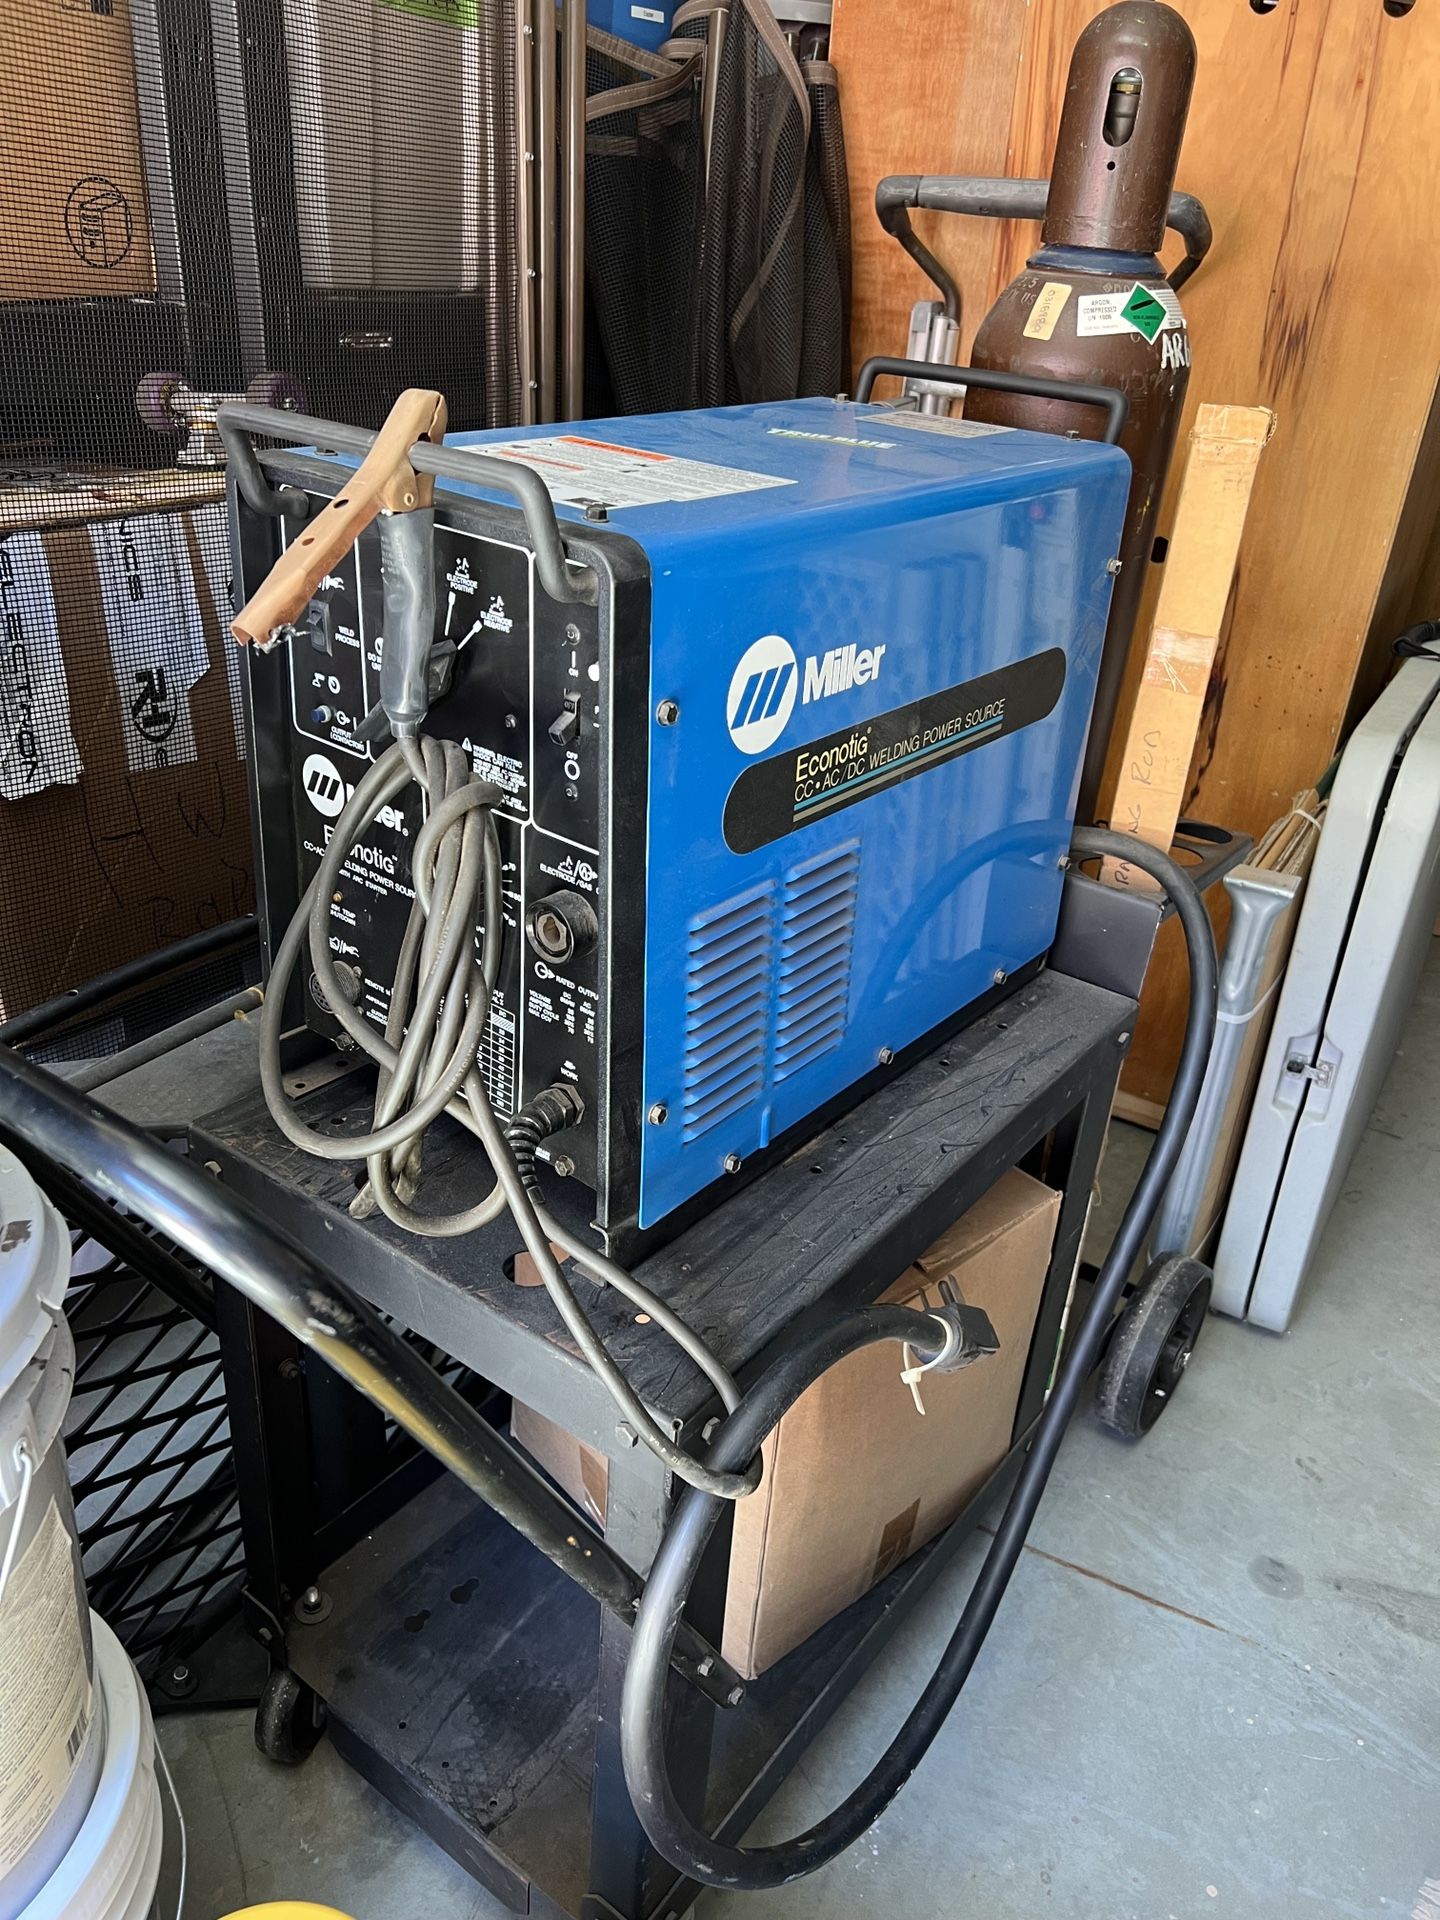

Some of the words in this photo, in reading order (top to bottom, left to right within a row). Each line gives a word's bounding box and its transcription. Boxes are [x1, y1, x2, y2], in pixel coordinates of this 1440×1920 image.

[802, 643, 885, 704] Miller
[869, 735, 920, 767] WELDING
[922, 717, 961, 745] POWER
[965, 698, 1006, 729] SOURCE
